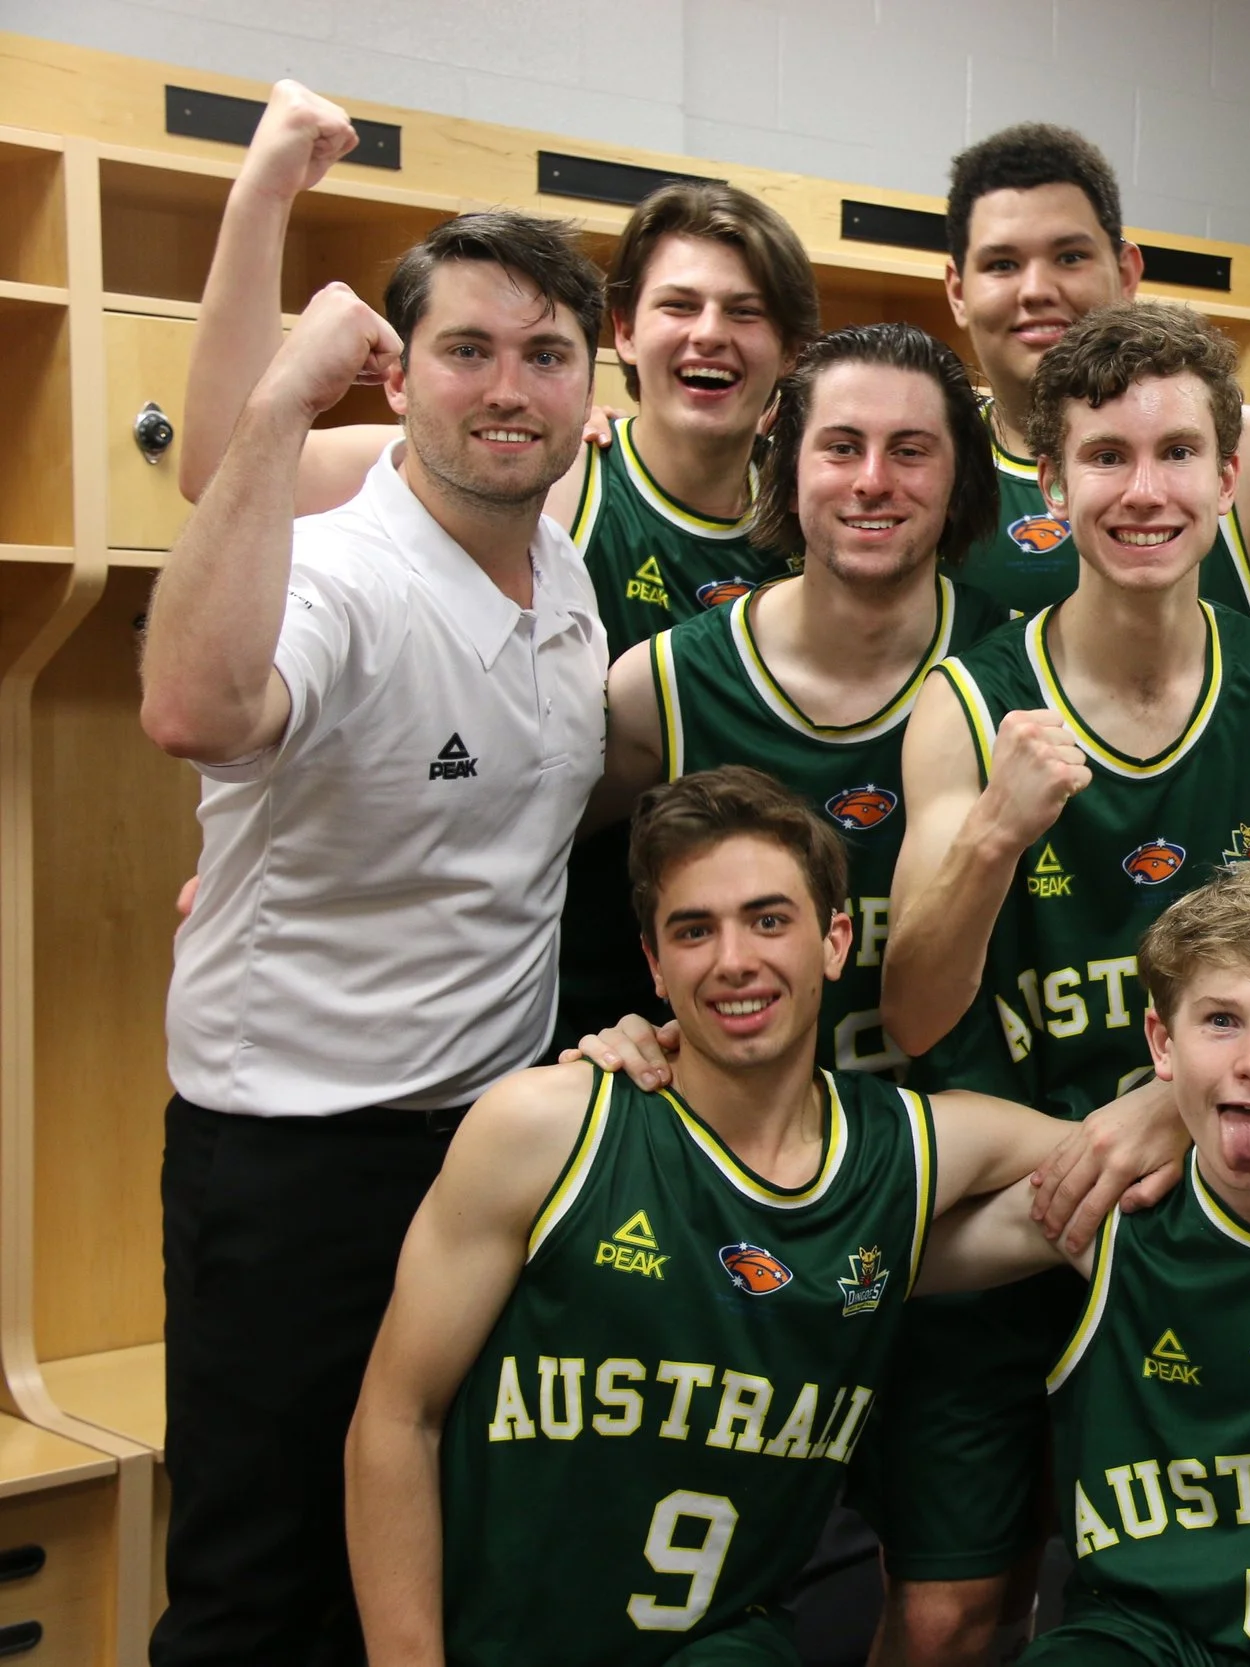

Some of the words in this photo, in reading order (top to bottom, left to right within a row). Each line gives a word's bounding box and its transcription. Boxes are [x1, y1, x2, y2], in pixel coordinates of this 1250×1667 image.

[429, 757, 479, 780] PEAK
[1027, 875, 1074, 898] PEAK
[594, 1240, 672, 1280] PEAK
[1142, 1356, 1202, 1386] PEAK
[489, 1356, 877, 1465] AUSTRALI
[626, 1489, 740, 1632] 9
